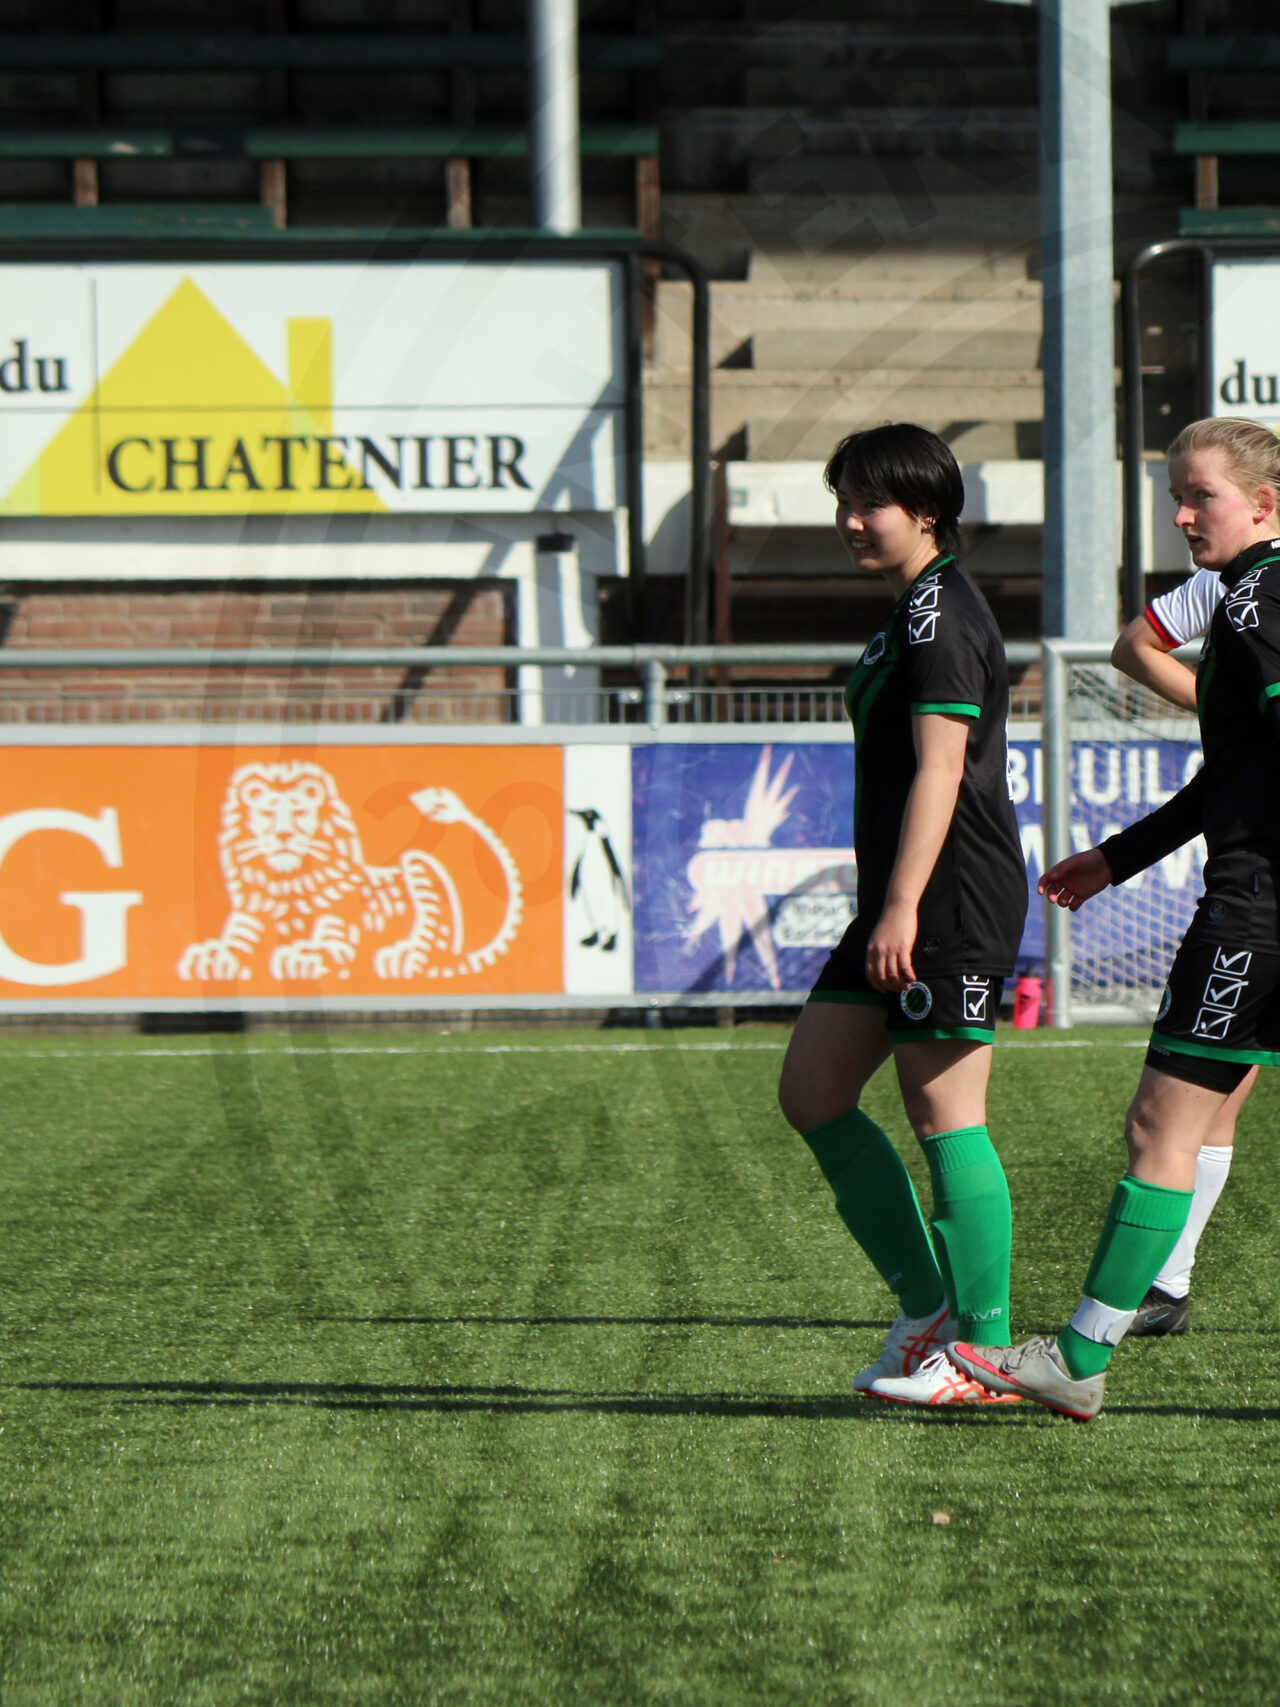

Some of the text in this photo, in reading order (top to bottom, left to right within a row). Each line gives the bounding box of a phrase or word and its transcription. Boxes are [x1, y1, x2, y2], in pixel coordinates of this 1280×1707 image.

[0, 340, 68, 392] du
[1220, 358, 1280, 405] du
[106, 435, 532, 492] CHATENIER
